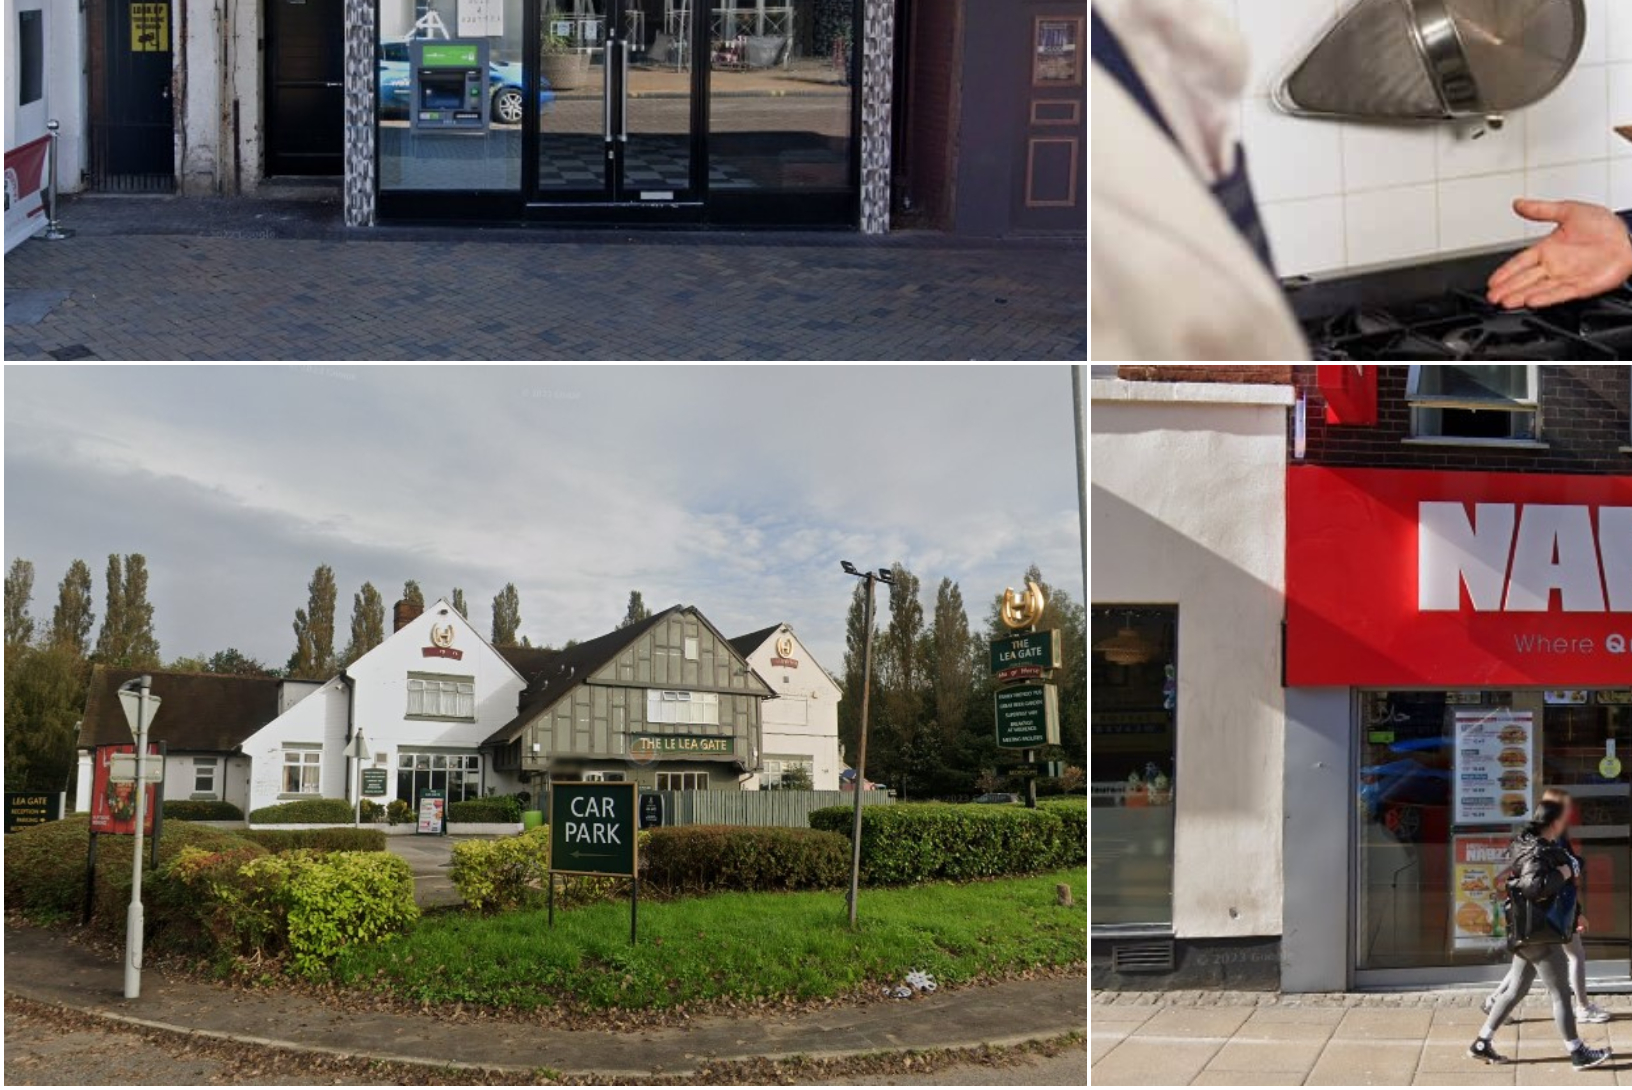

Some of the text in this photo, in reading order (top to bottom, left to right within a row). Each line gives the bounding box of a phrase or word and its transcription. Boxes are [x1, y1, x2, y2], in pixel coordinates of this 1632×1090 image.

[1011, 639, 1029, 649] THE
[1514, 632, 1599, 656] Where
[1000, 647, 1042, 662] LEA GATE
[640, 737, 727, 751] THE LE LEA GATE
[12, 796, 47, 805] LEA GATE
[570, 796, 616, 819] CAR
[564, 822, 622, 845] PARK
